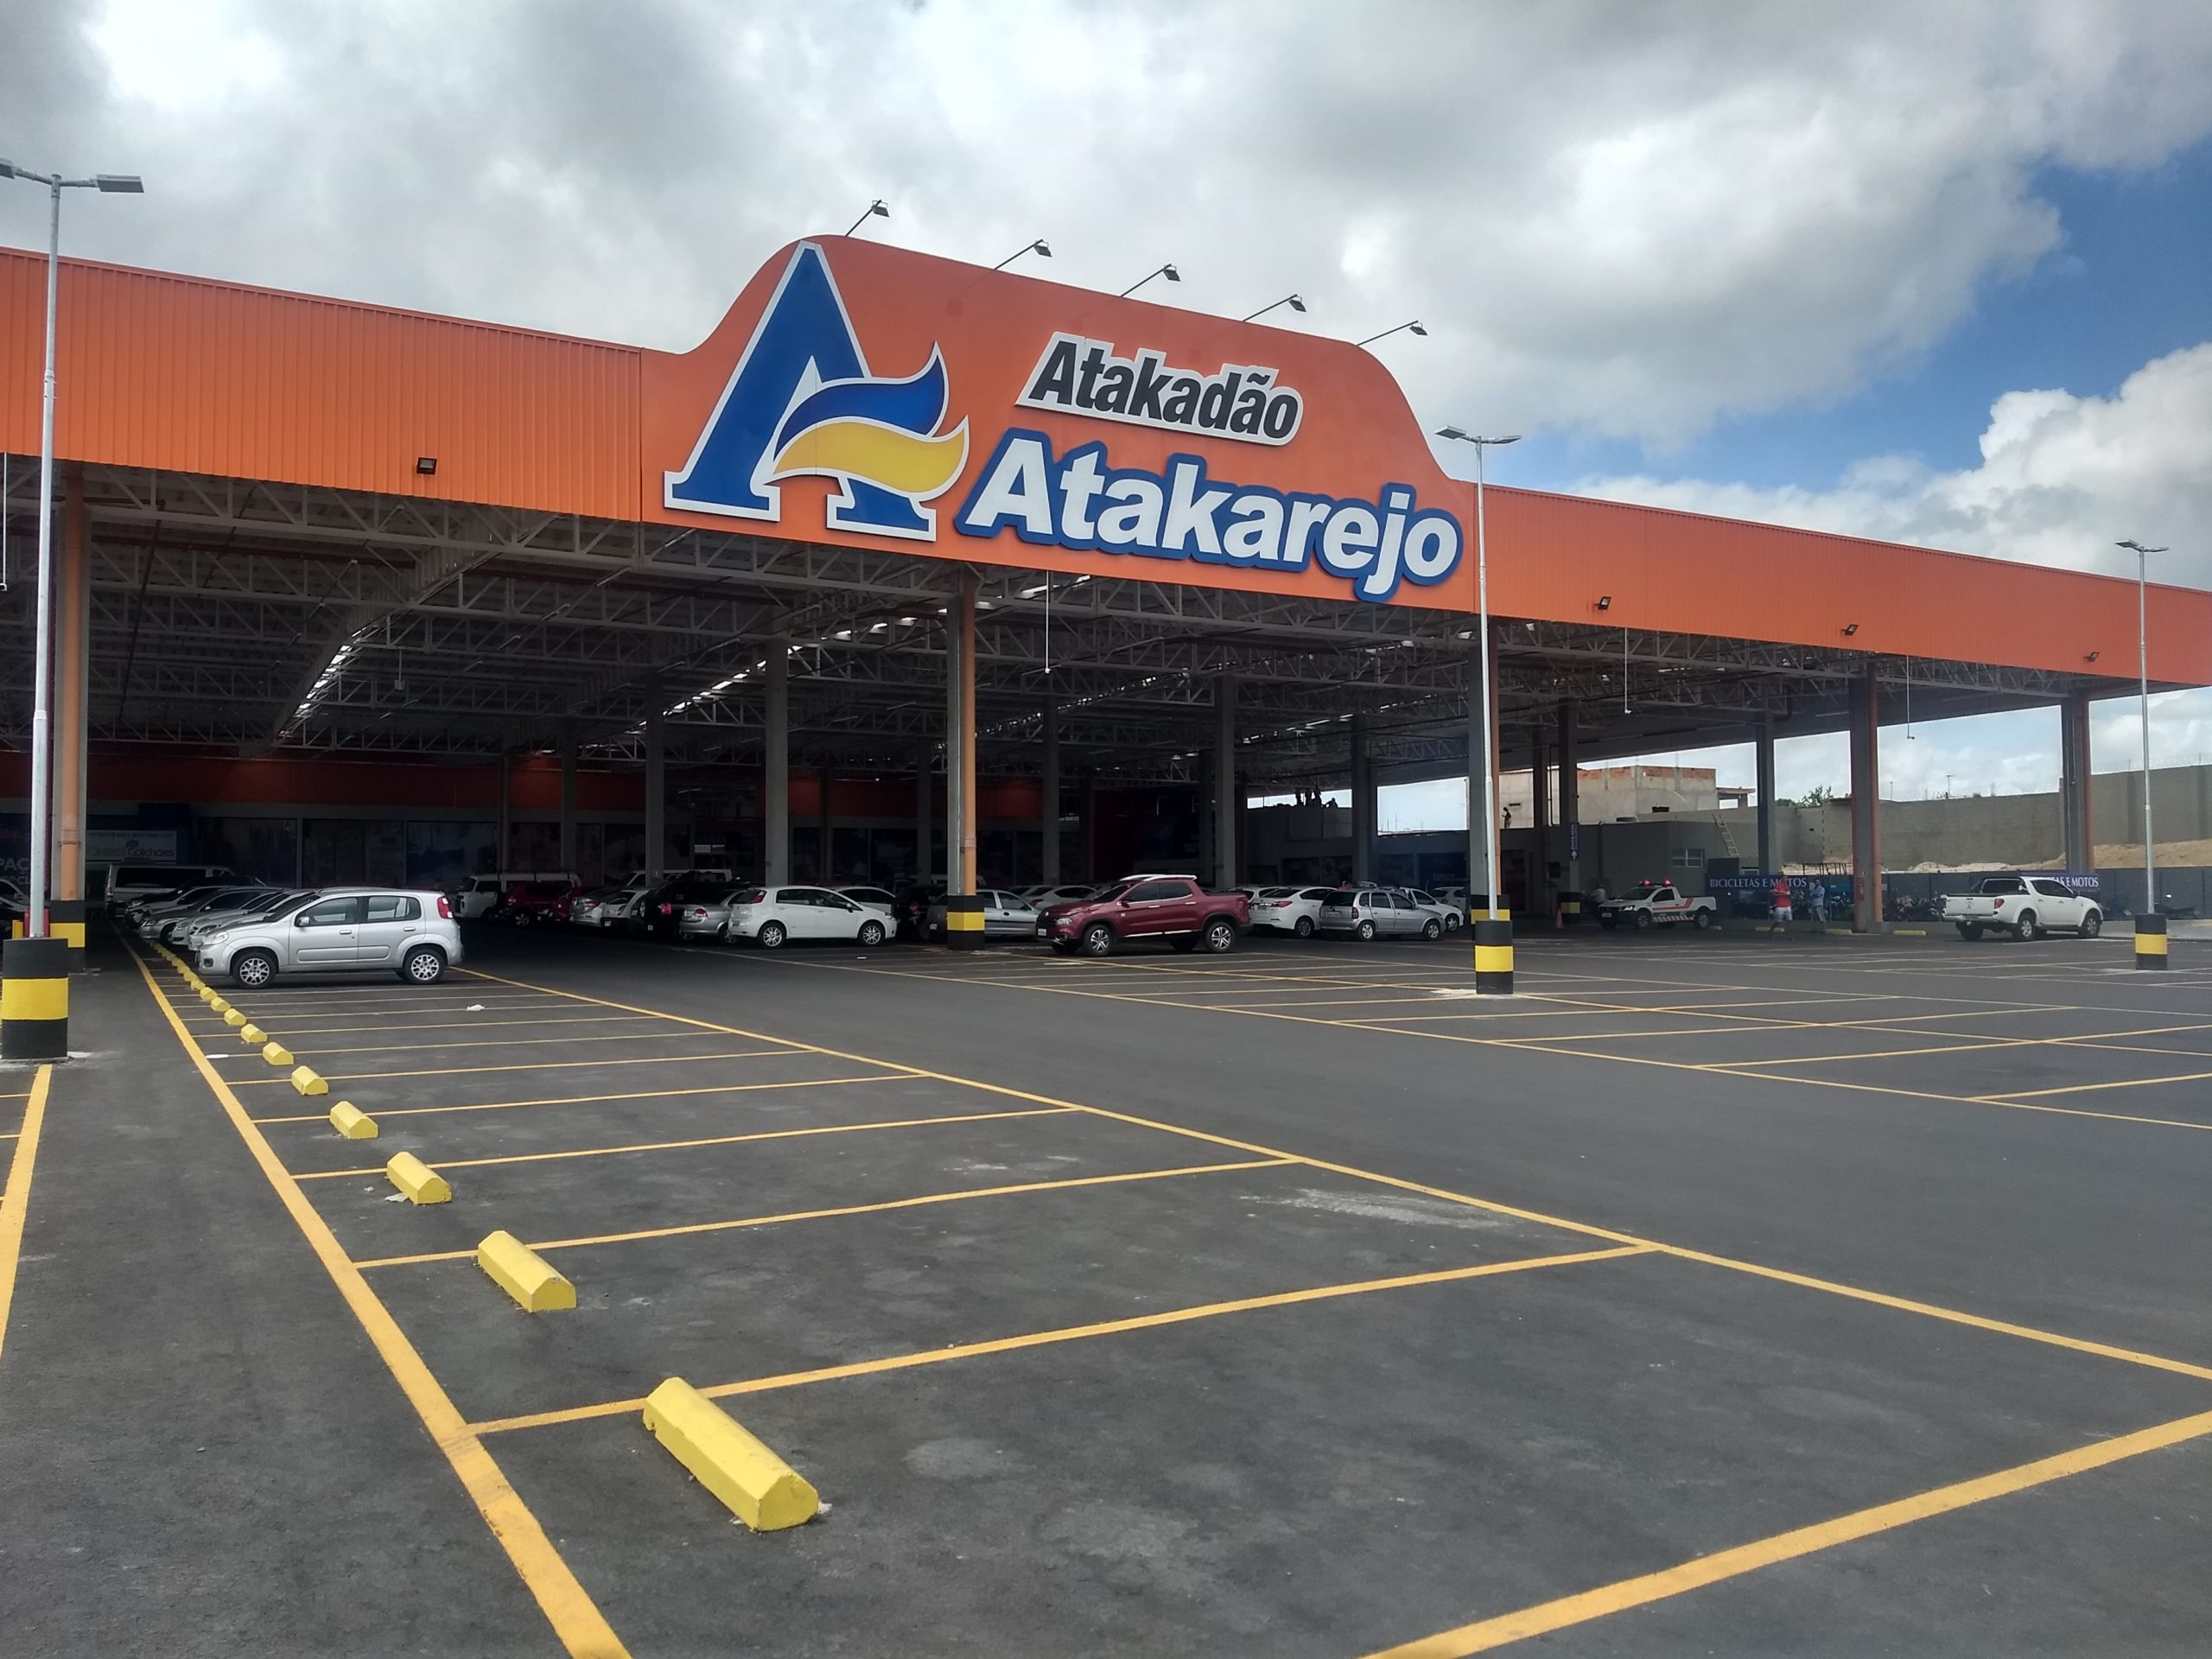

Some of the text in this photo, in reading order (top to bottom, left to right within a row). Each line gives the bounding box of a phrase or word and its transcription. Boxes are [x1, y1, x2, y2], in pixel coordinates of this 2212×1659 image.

[1028, 340, 1298, 439] Atakadão
[964, 437, 1458, 595] Atakarejo
[1710, 878, 1760, 887] BICICLETAS
[1763, 878, 1768, 887] E
[2066, 876, 2071, 887] E
[2071, 877, 2099, 887] MOTOS
